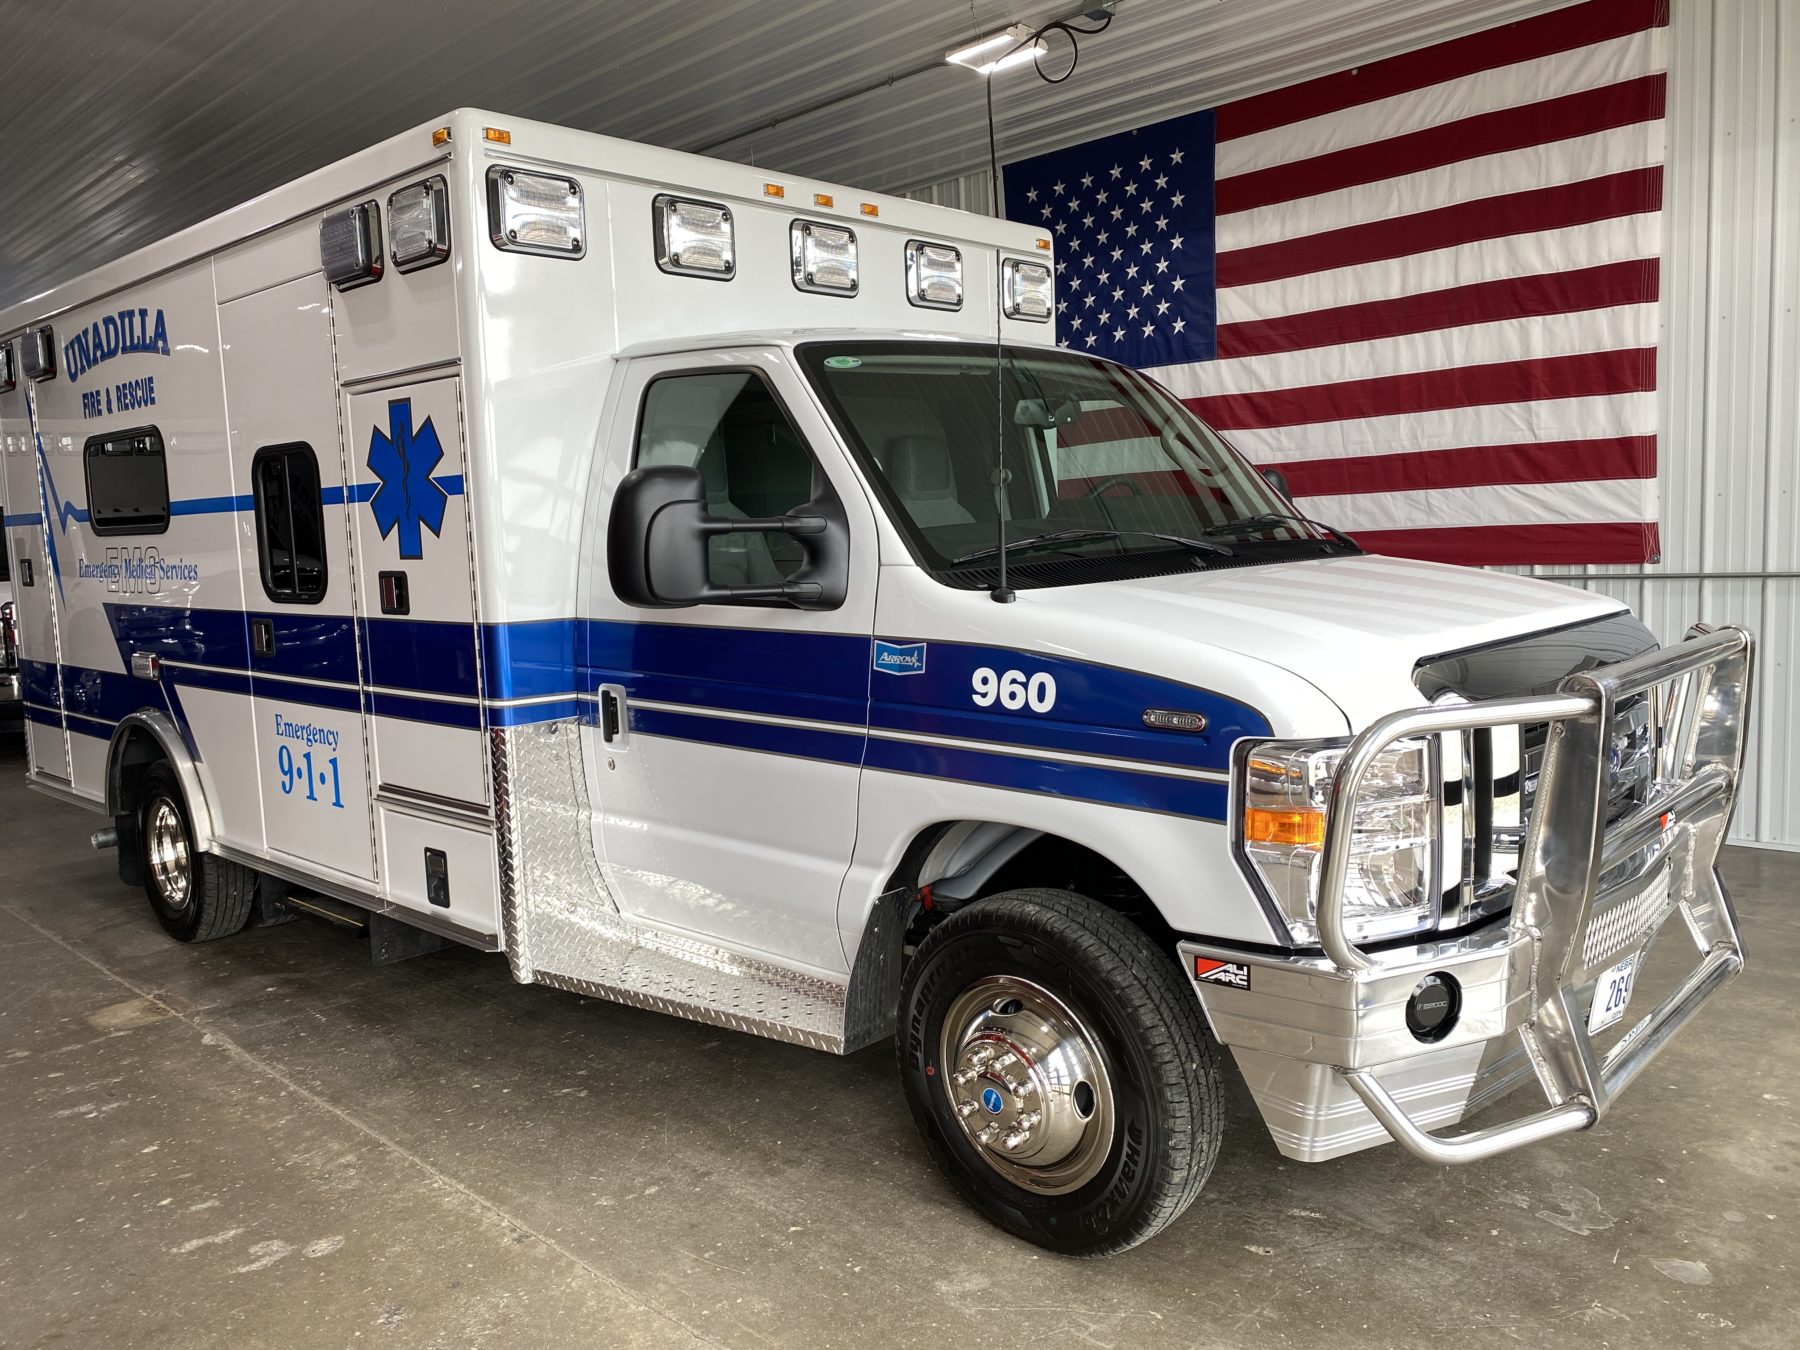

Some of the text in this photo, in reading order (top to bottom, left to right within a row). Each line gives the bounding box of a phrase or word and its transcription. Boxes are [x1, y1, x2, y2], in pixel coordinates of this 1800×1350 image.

[63, 308, 170, 383] UNADILLA
[82, 376, 156, 419] FIRE & RESCUE
[78, 557, 198, 583] Emergency Medical Services
[105, 546, 161, 595] EMS
[971, 667, 1057, 714] 960
[275, 714, 338, 752] Emergency
[1199, 963, 1248, 978] ALI
[1207, 971, 1248, 986] ARC
